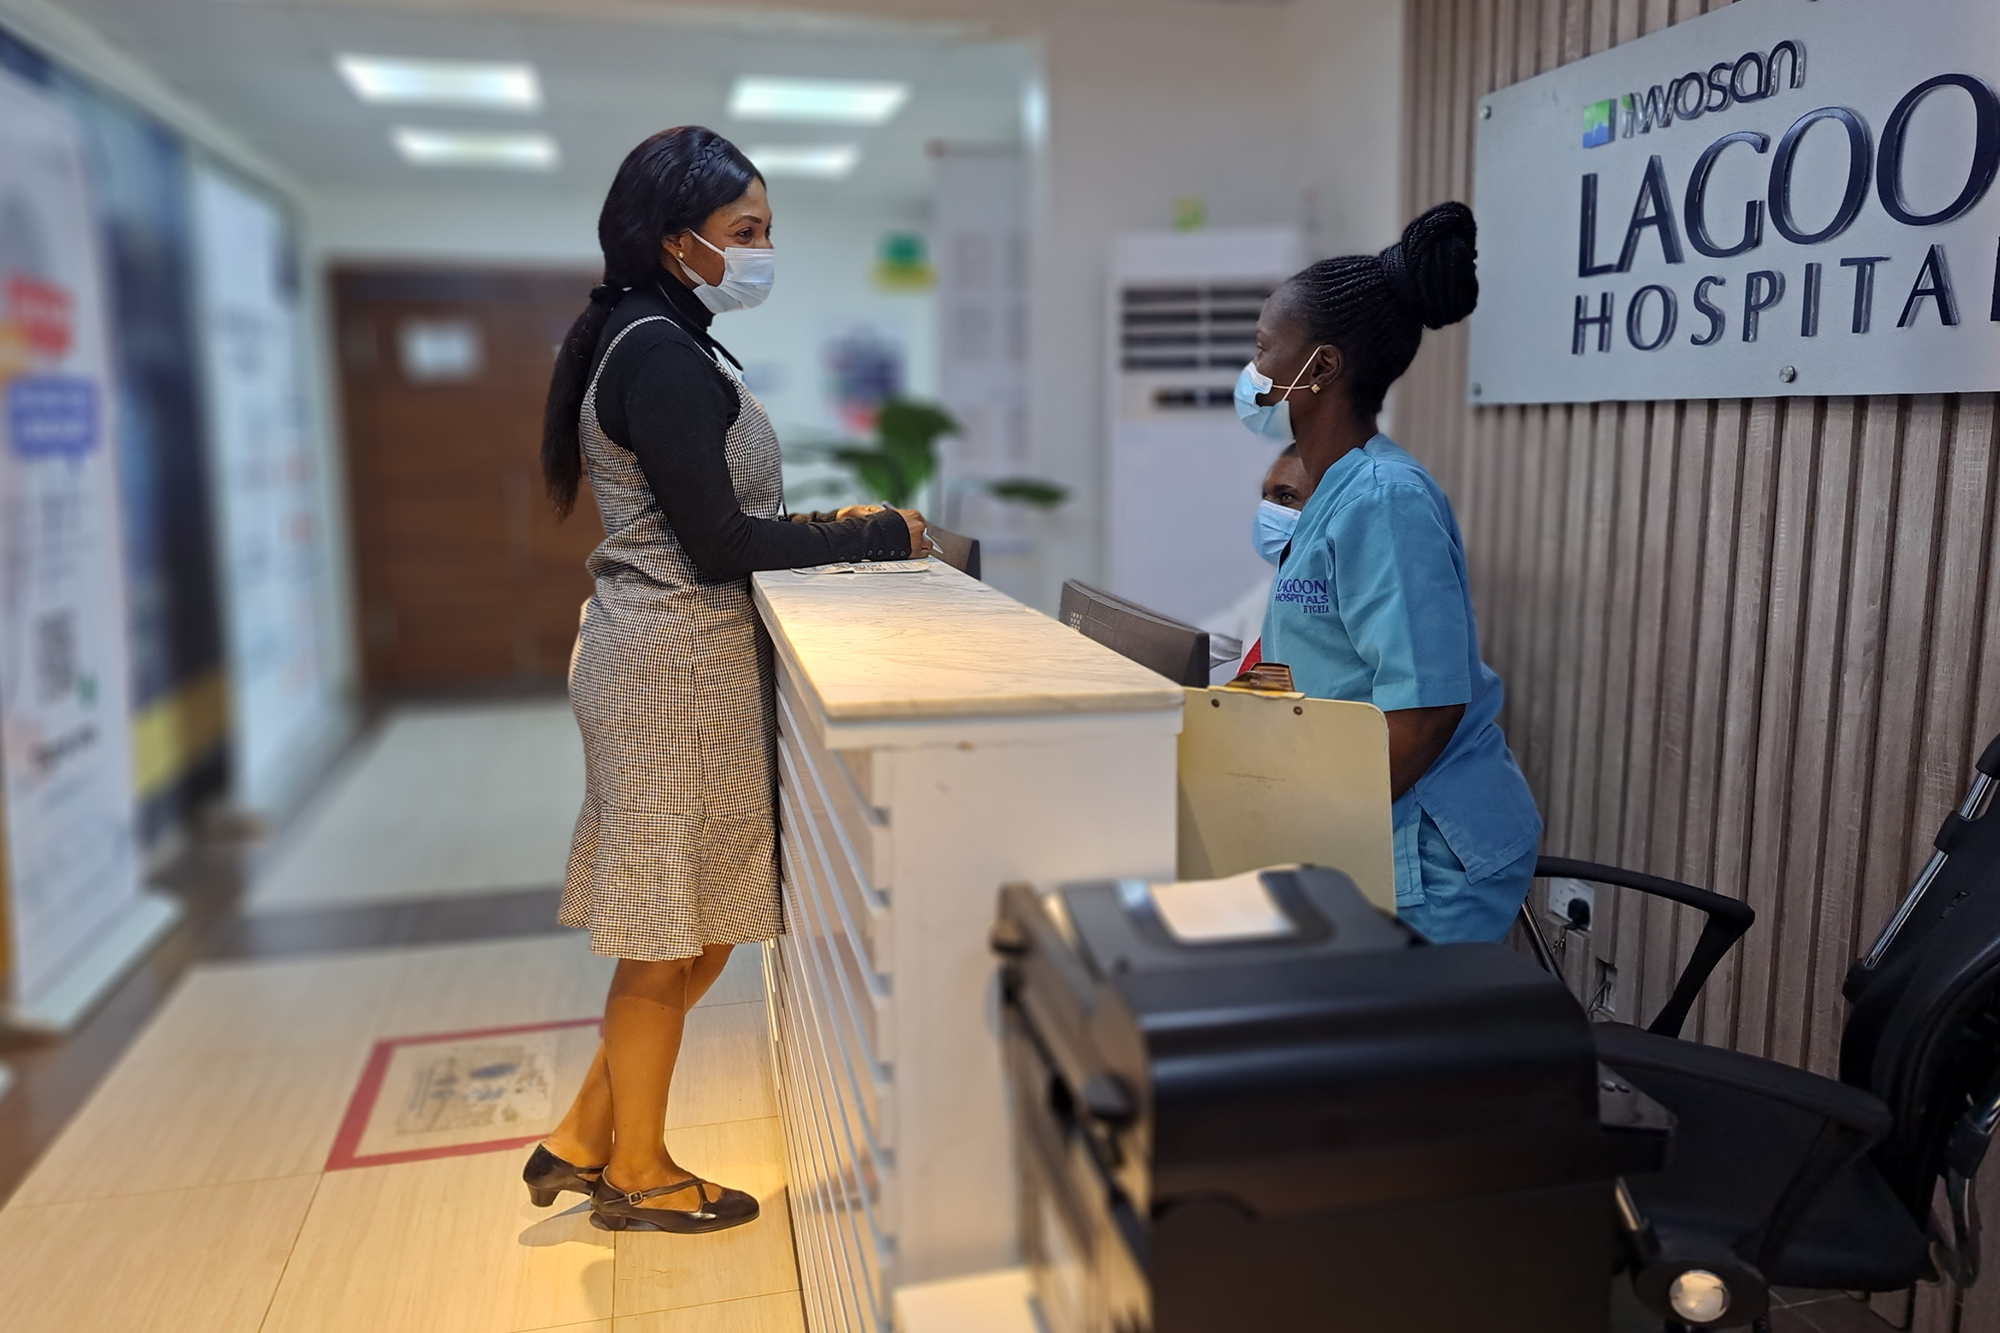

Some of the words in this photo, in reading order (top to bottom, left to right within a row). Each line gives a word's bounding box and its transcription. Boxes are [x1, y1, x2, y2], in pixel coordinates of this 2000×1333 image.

[1622, 40, 1806, 138] iwosan
[1571, 237, 2000, 355] HOSPITA
[1275, 593, 1329, 604] HOSPITALS
[1277, 578, 1327, 594] LAGOON
